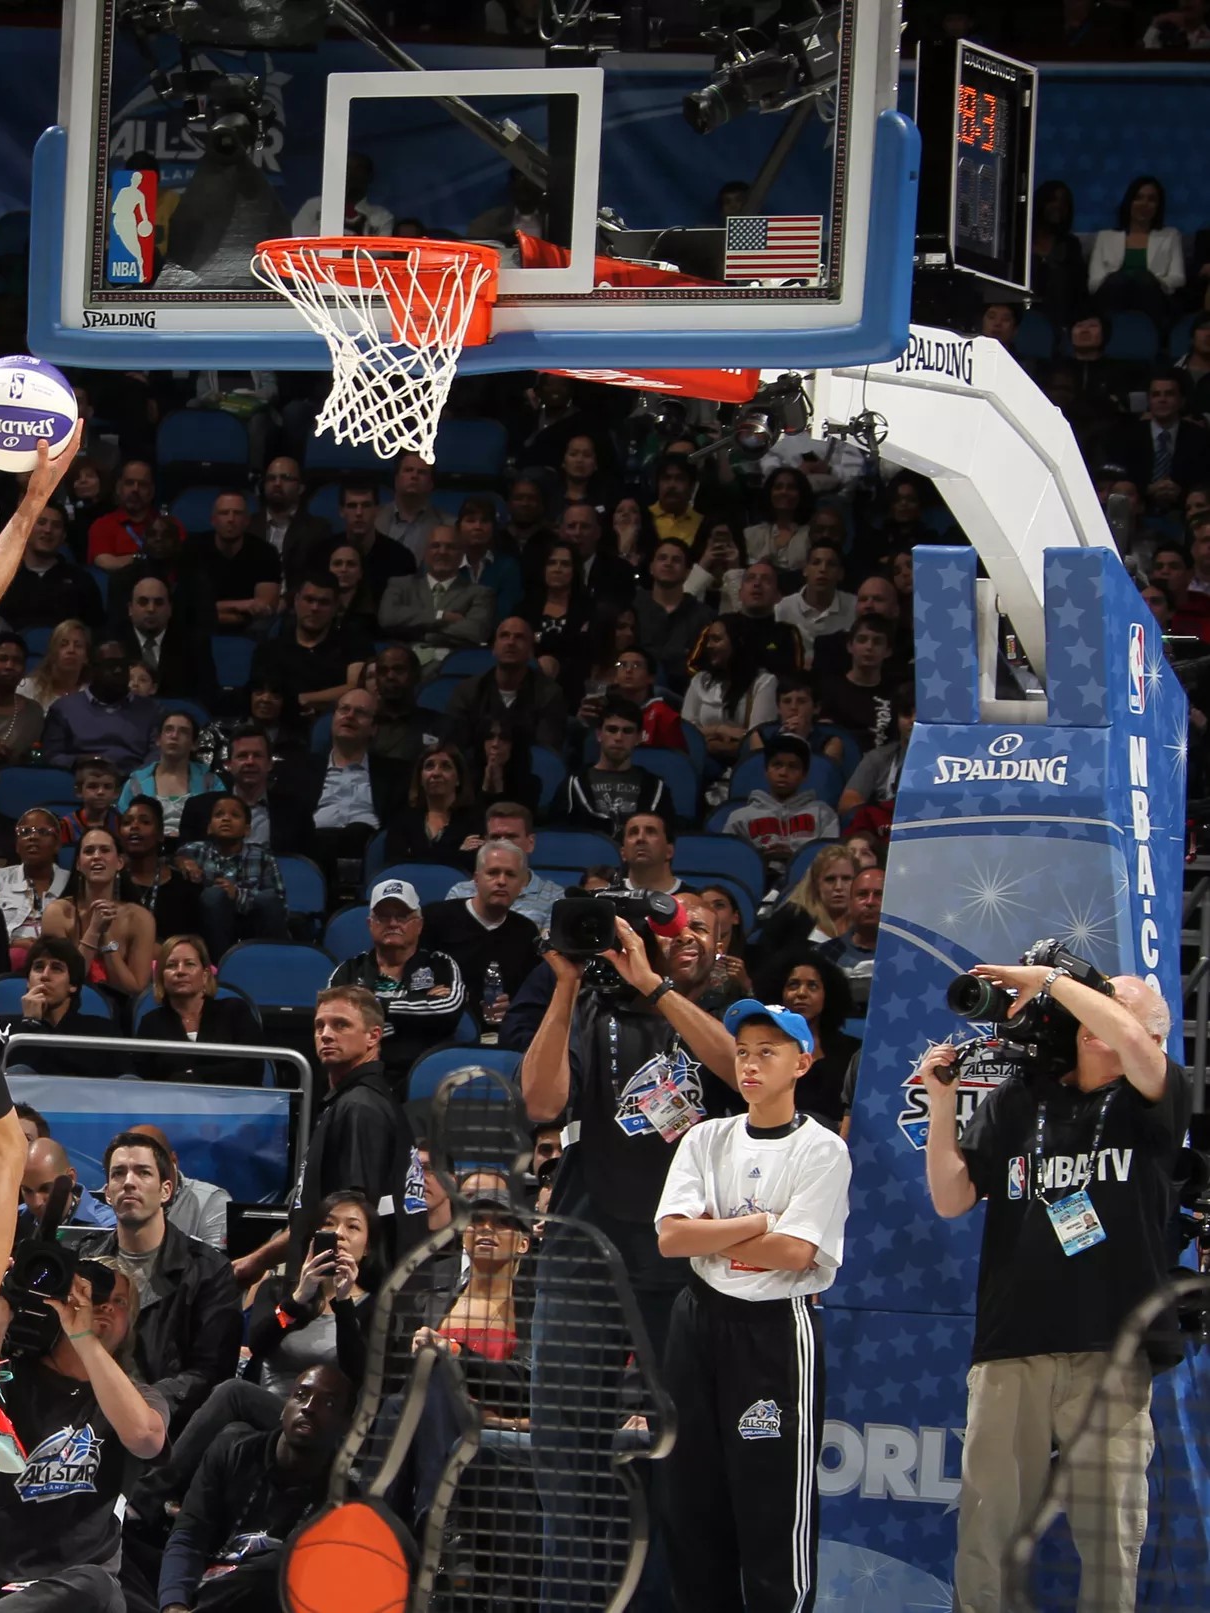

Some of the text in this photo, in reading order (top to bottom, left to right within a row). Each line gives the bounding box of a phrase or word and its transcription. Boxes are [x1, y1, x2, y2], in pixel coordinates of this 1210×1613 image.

[963, 51, 1017, 82] DAKTRONICS
[111, 260, 138, 278] NBA
[82, 310, 157, 330] SPALDING
[933, 755, 1069, 786] SPALDING
[1040, 1147, 1133, 1189] NBA TV
